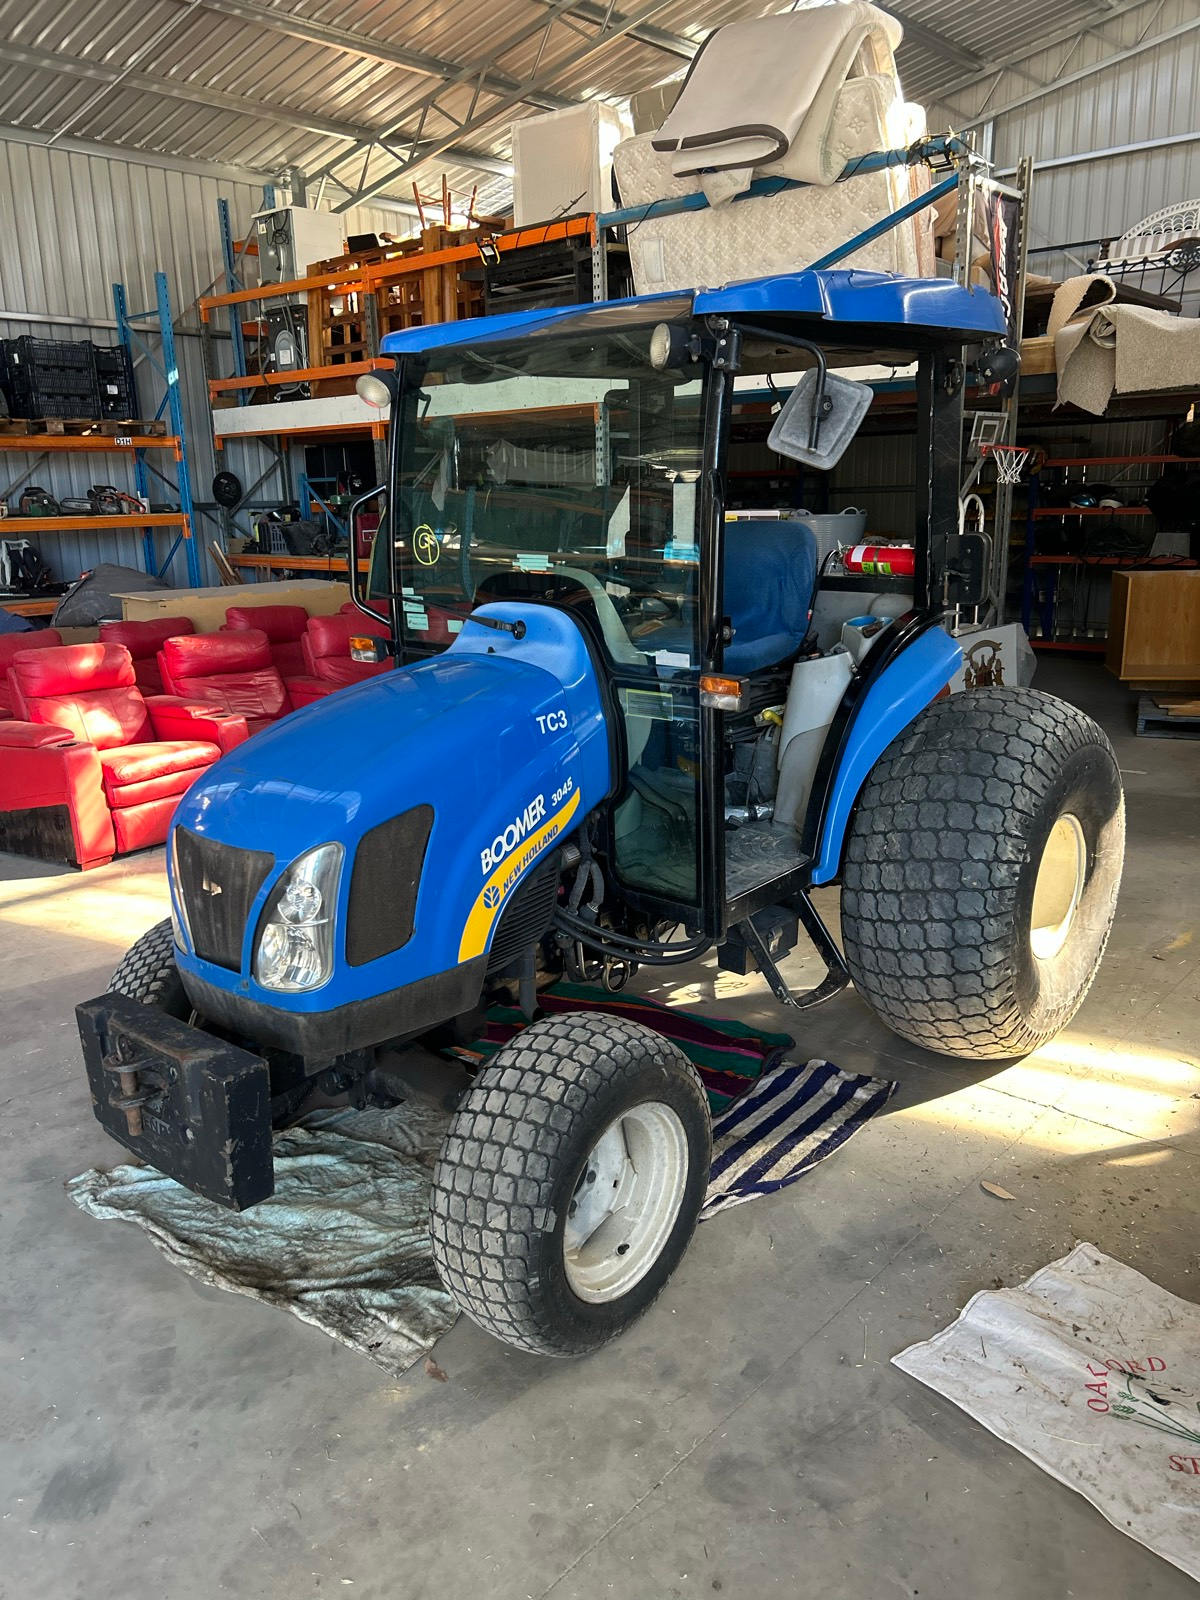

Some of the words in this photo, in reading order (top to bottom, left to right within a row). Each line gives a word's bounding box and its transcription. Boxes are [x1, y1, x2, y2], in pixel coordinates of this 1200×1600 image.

[536, 710, 568, 735] TC3
[480, 793, 546, 876] BOOMER
[551, 776, 573, 807] 3045
[503, 861, 522, 893] NEW
[522, 824, 559, 867] HOLLAND
